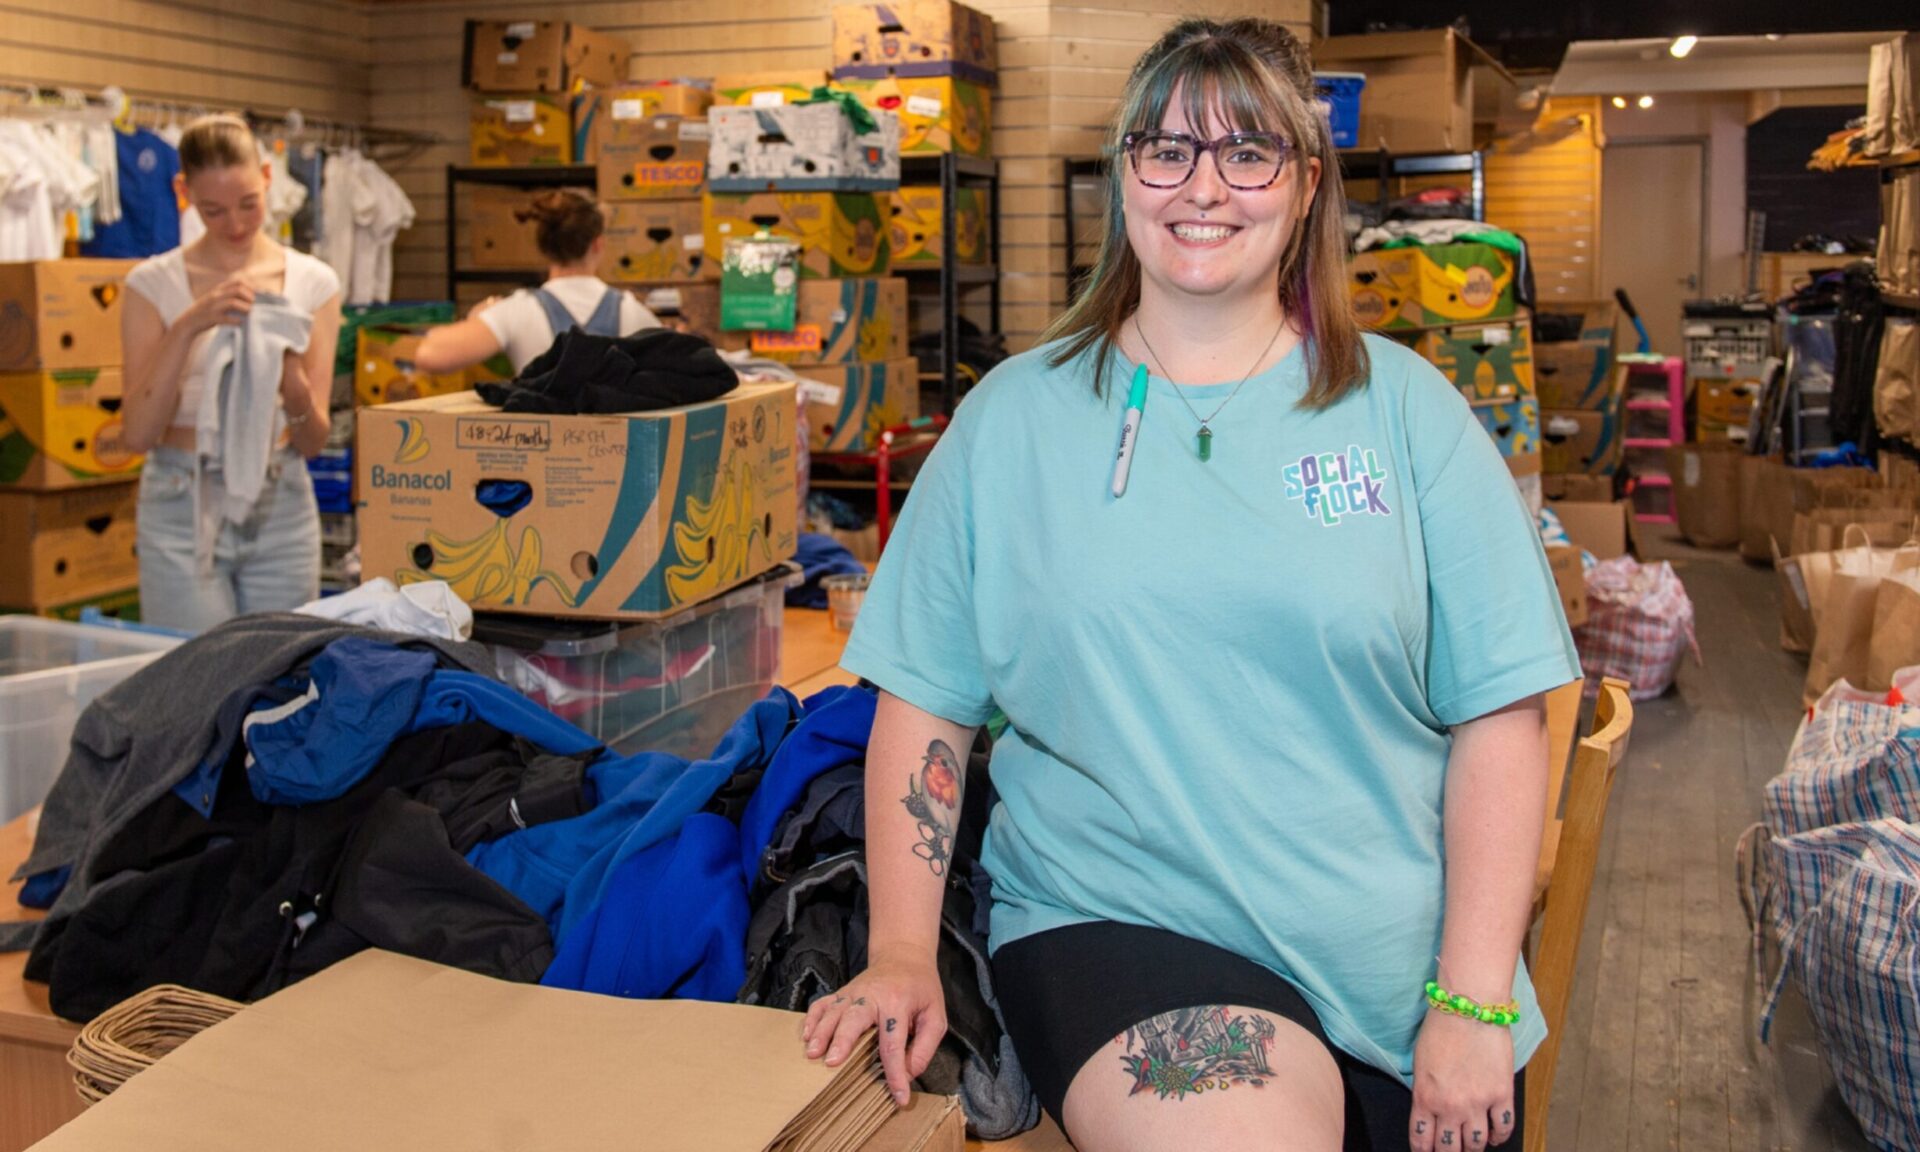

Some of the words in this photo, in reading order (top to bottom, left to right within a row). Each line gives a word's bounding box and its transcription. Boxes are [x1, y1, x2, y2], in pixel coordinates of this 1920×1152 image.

[641, 166, 701, 181] TESCO
[371, 465, 451, 490] Banacol
[1282, 444, 1387, 499] SOCIAL
[1303, 475, 1392, 527] FLOCK
